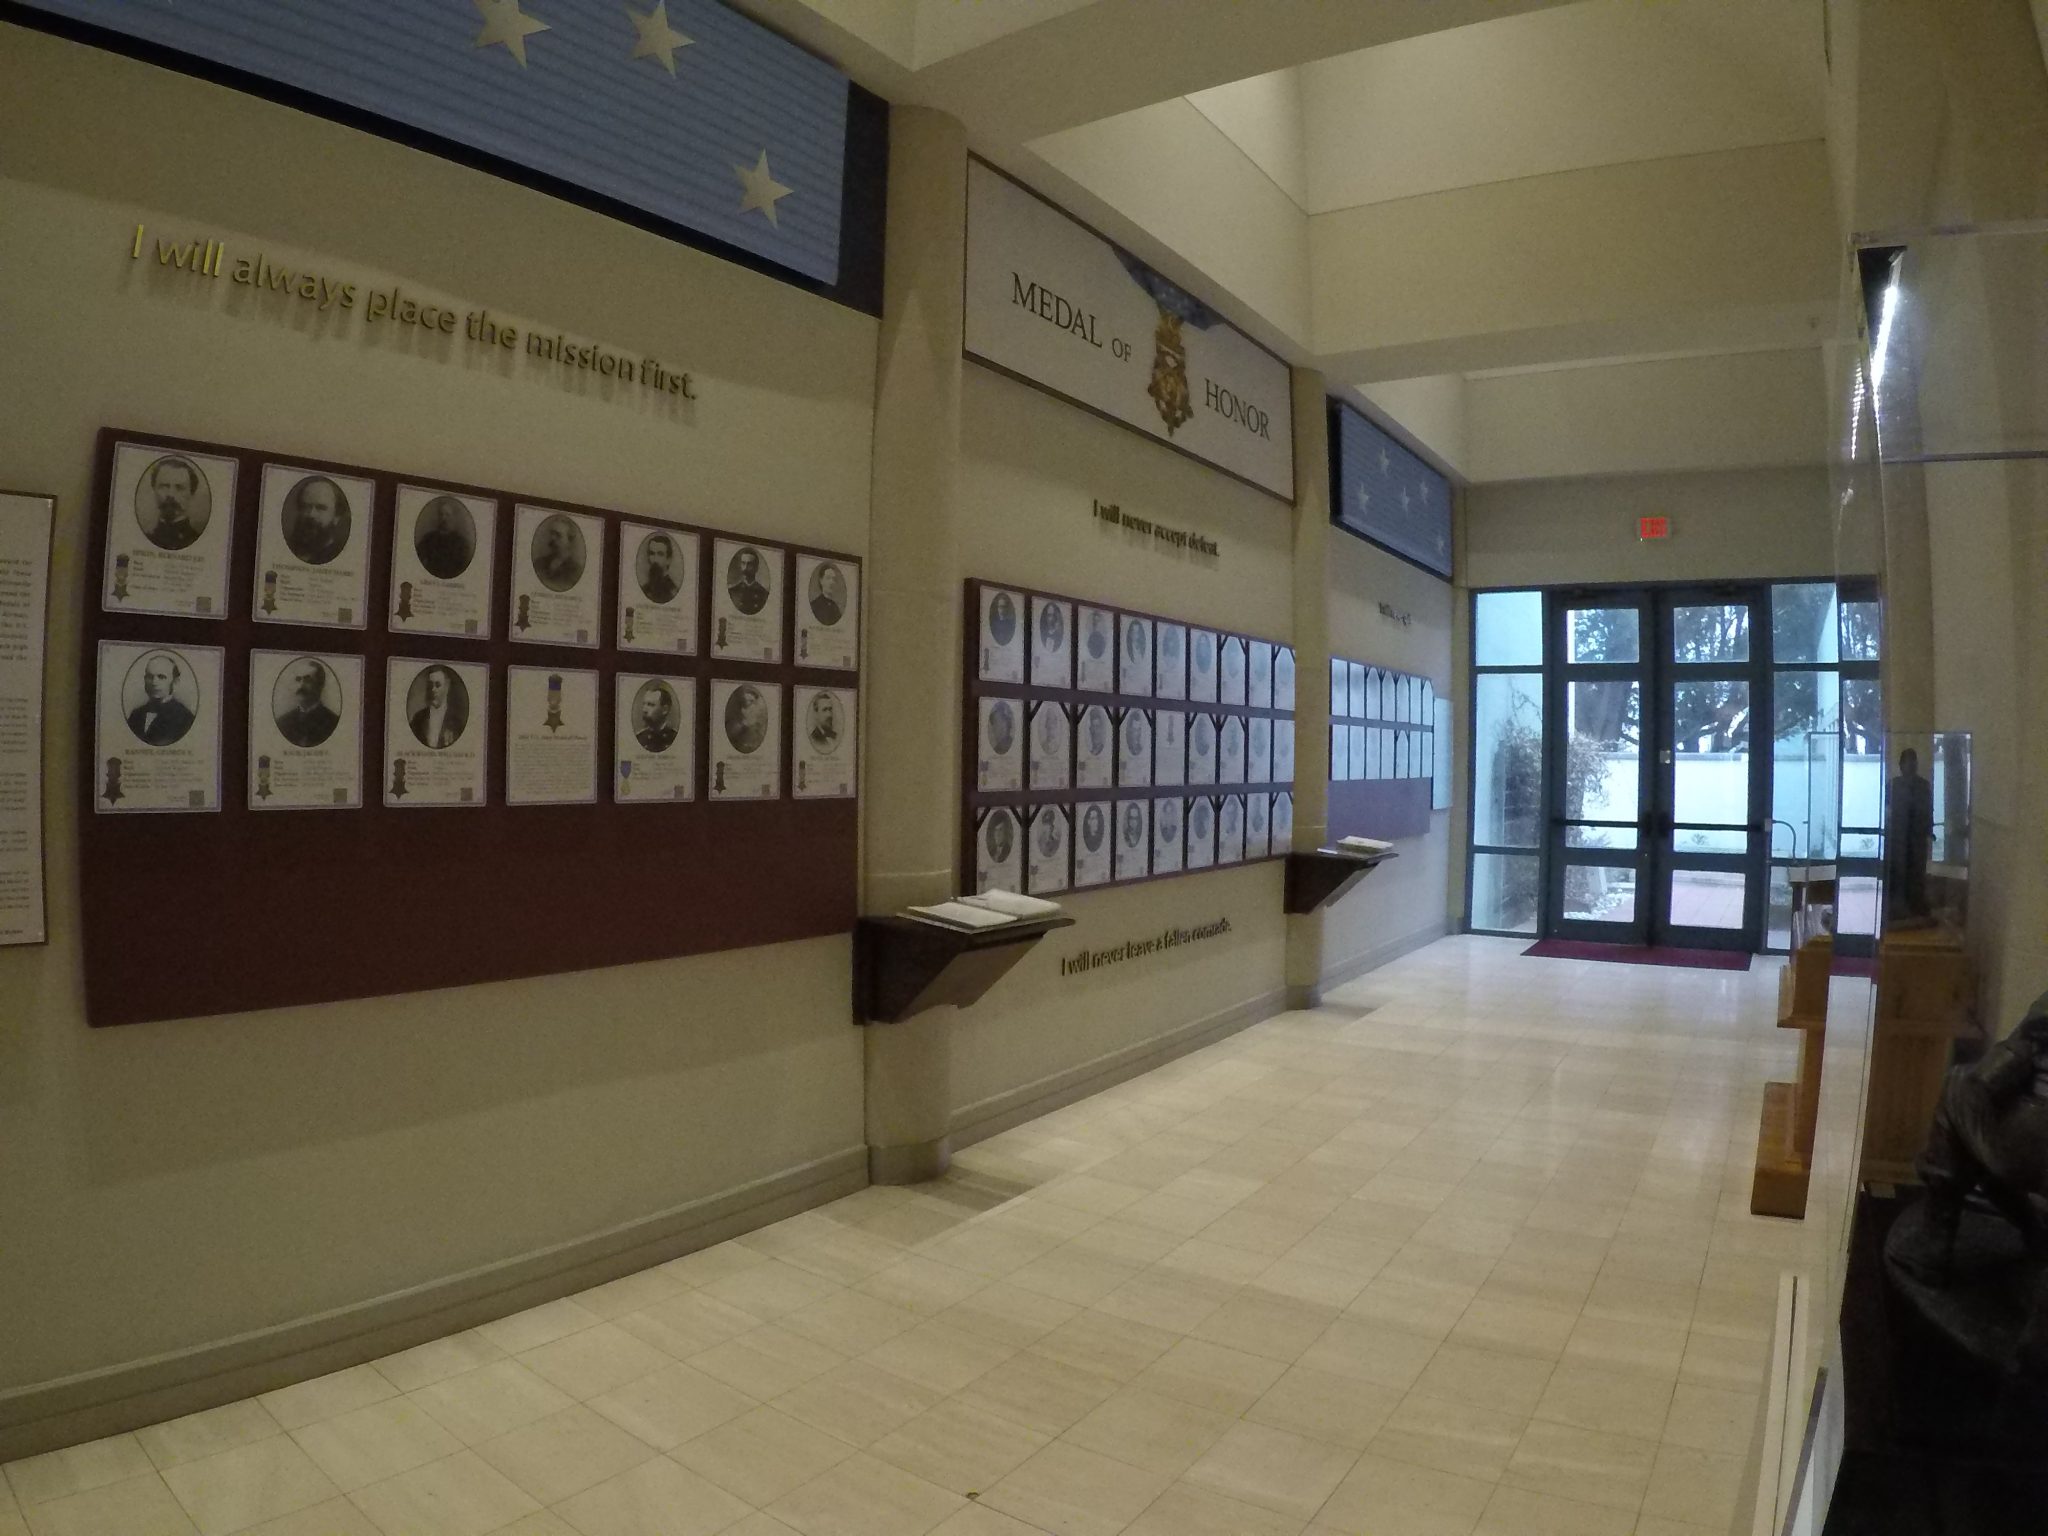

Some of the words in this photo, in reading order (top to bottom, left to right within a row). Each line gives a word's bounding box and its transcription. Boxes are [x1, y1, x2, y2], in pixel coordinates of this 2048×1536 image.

[131, 223, 144, 259] I
[156, 237, 225, 278] will
[232, 252, 356, 311] always
[366, 286, 457, 335] place
[464, 309, 518, 350] the
[525, 330, 634, 384] mission
[640, 357, 698, 401] first.
[1010, 271, 1103, 349] MEDAL
[1111, 338, 1132, 362] OF
[1204, 377, 1271, 441] HONOR
[1100, 504, 1120, 524] will
[1068, 950, 1090, 975] will
[1092, 947, 1124, 969] never
[1126, 941, 1155, 960] leave
[1164, 928, 1191, 950] fallen
